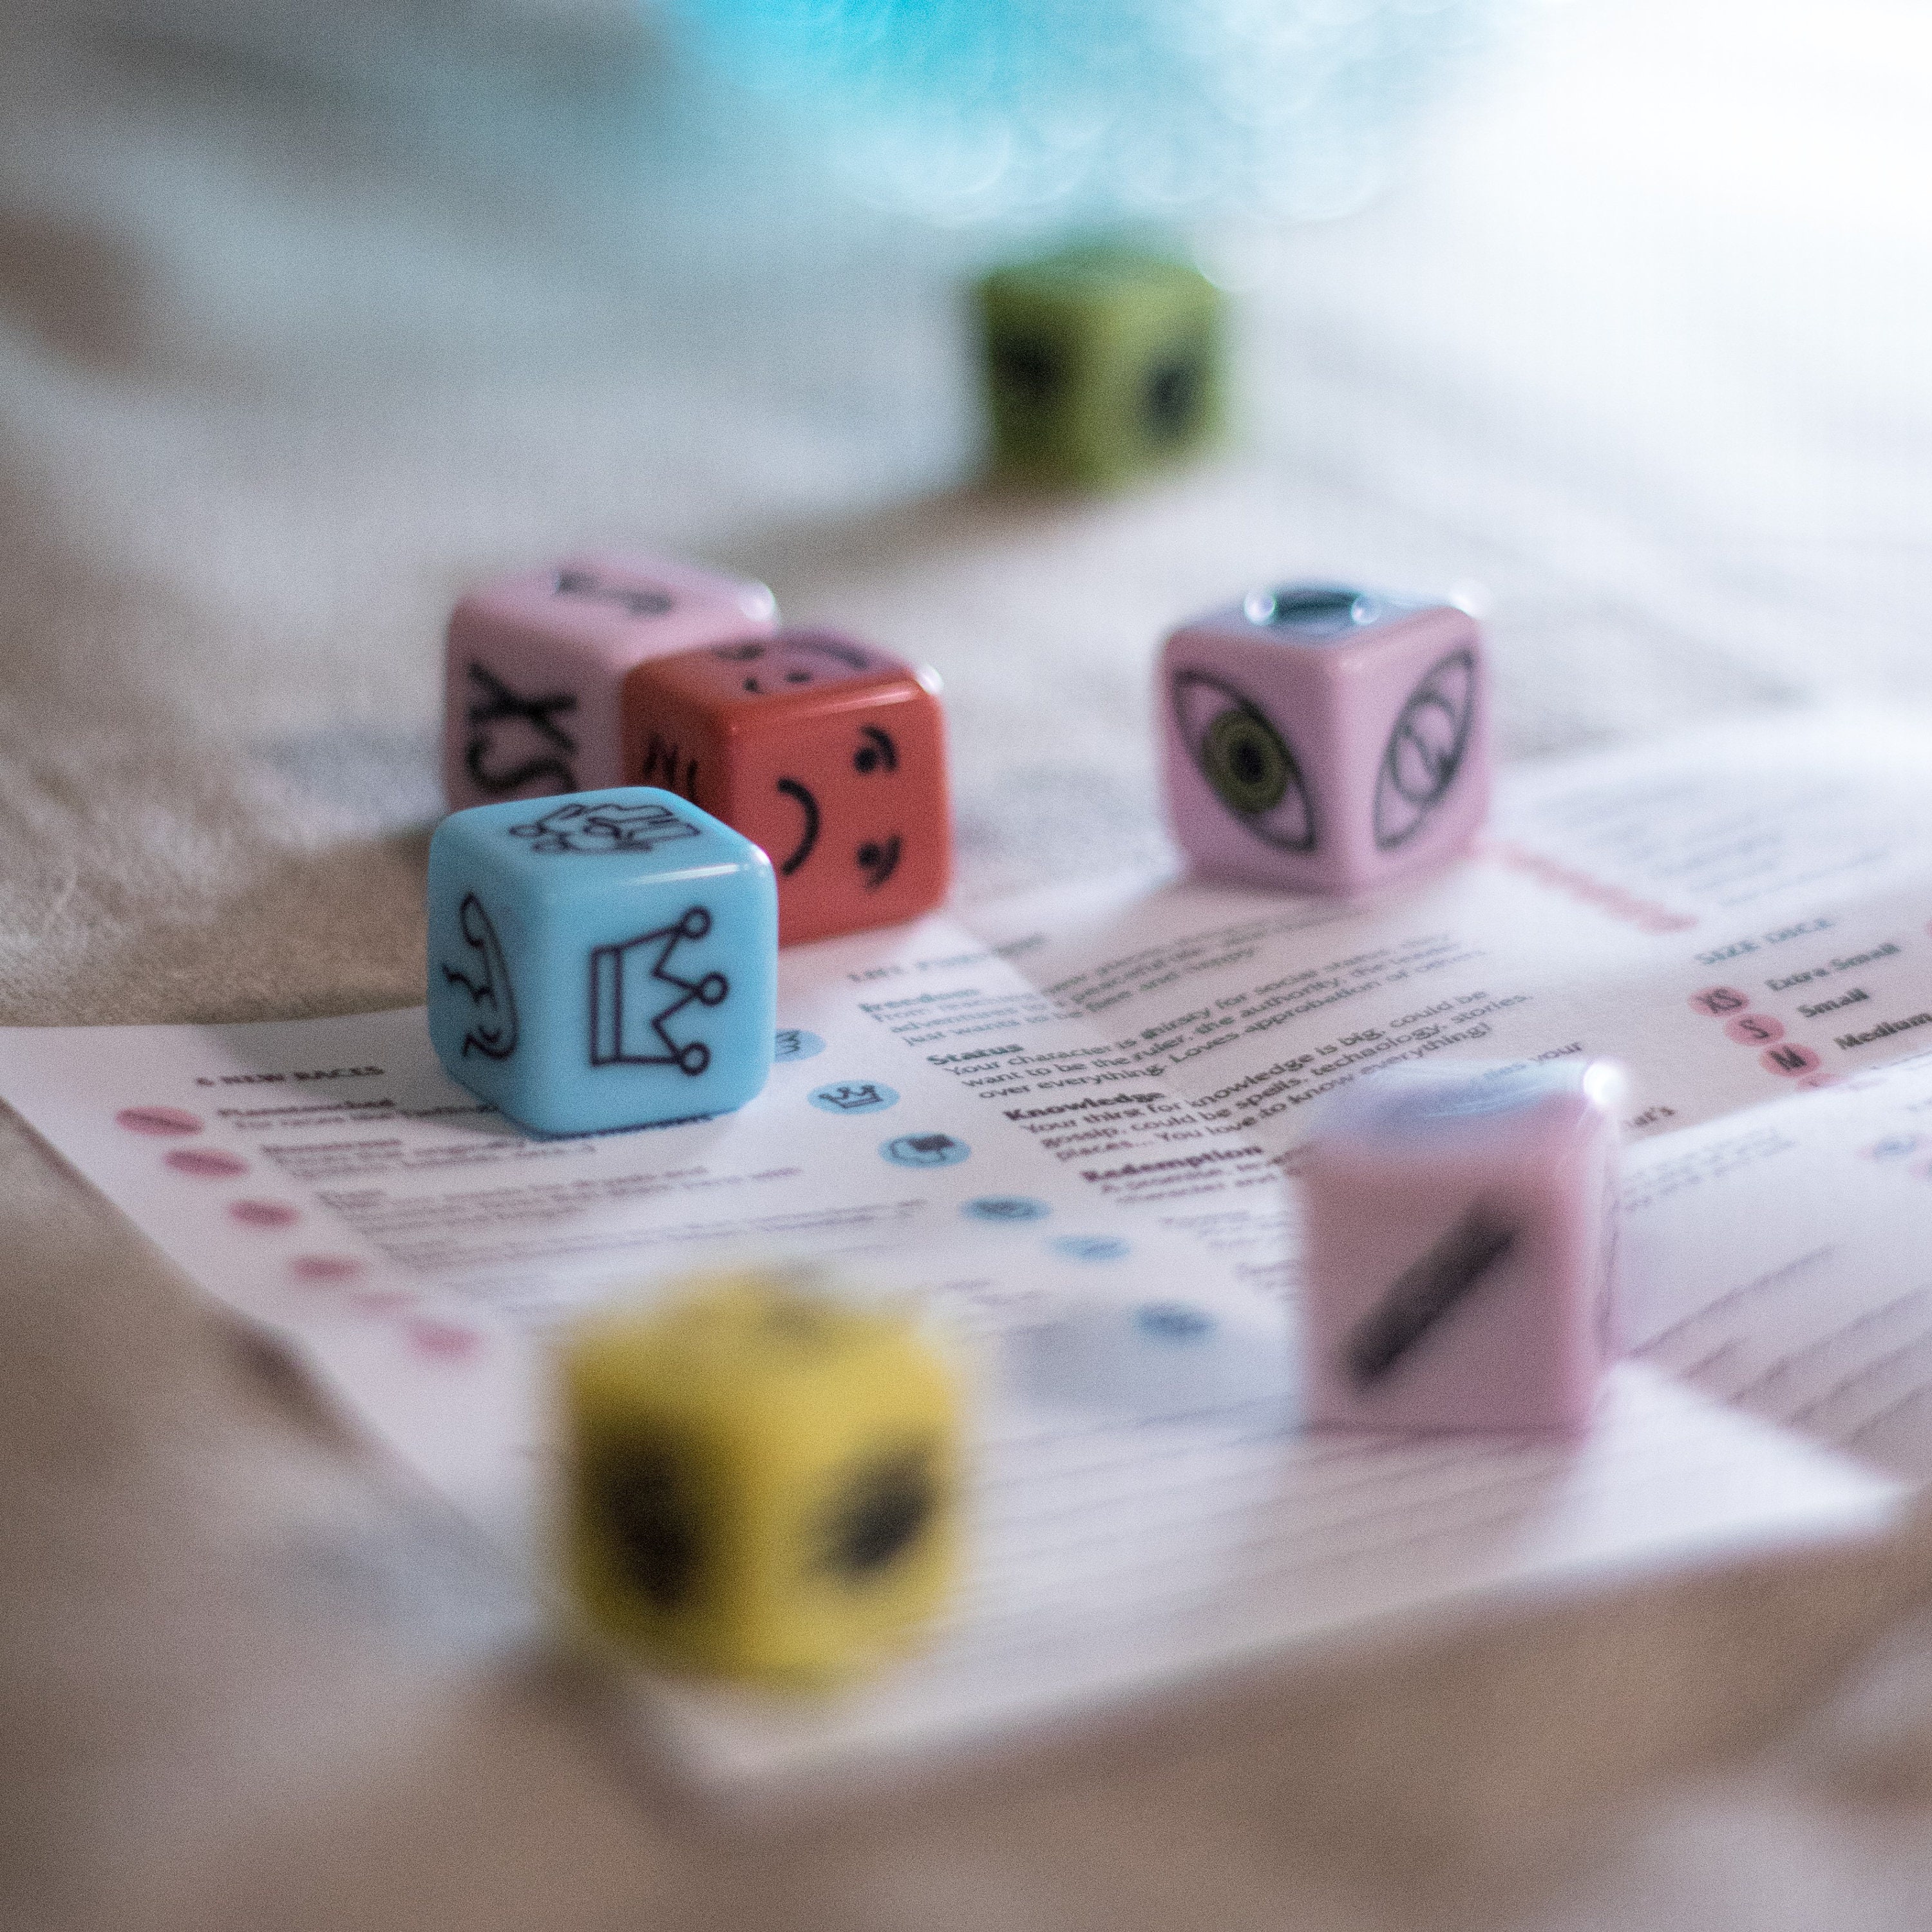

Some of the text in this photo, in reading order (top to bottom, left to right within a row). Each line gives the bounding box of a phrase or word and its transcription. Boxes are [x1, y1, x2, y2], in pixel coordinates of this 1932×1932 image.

[1694, 941, 1902, 1014] XS Extra Small
[943, 1061, 1001, 1077] Your
[1007, 1046, 1112, 1066] character
[1115, 1038, 1137, 1050] is
[1215, 993, 1247, 1010] for
[1254, 969, 1318, 996] social
[978, 1085, 1032, 1100] over
[1168, 1032, 1240, 1064] Loves
[1244, 980, 1382, 1034] approbation
[1738, 986, 1873, 1040] S Small
[220, 1072, 287, 1085] NEW
[292, 1065, 386, 1083] RACES
[926, 1043, 1025, 1067] Status
[961, 1072, 1025, 1088] want
[1025, 1068, 1052, 1077] to
[1054, 1063, 1087, 1073] be
[1092, 1057, 1131, 1068] the
[1194, 1016, 1236, 1034] the
[1019, 1118, 1078, 1134] Your
[1082, 1106, 1145, 1125] thirst
[1146, 1101, 1183, 1115] for
[1187, 1054, 1315, 1108] knowledge
[1314, 1043, 1339, 1056] is
[1389, 1000, 1454, 1029] could
[1454, 990, 1488, 1005] be
[1767, 1044, 1808, 1072] M
[1002, 1092, 1166, 1122] Knowledge
[1155, 1128, 1203, 1144] You
[1206, 1115, 1258, 1134] love
[1258, 1102, 1287, 1119] to
[1288, 1073, 1356, 1106] know
[1359, 1021, 1493, 1076] everything!
[1130, 1115, 1197, 1132] could
[1199, 1107, 1231, 1122] be
[1079, 1146, 1264, 1184] Redemption
